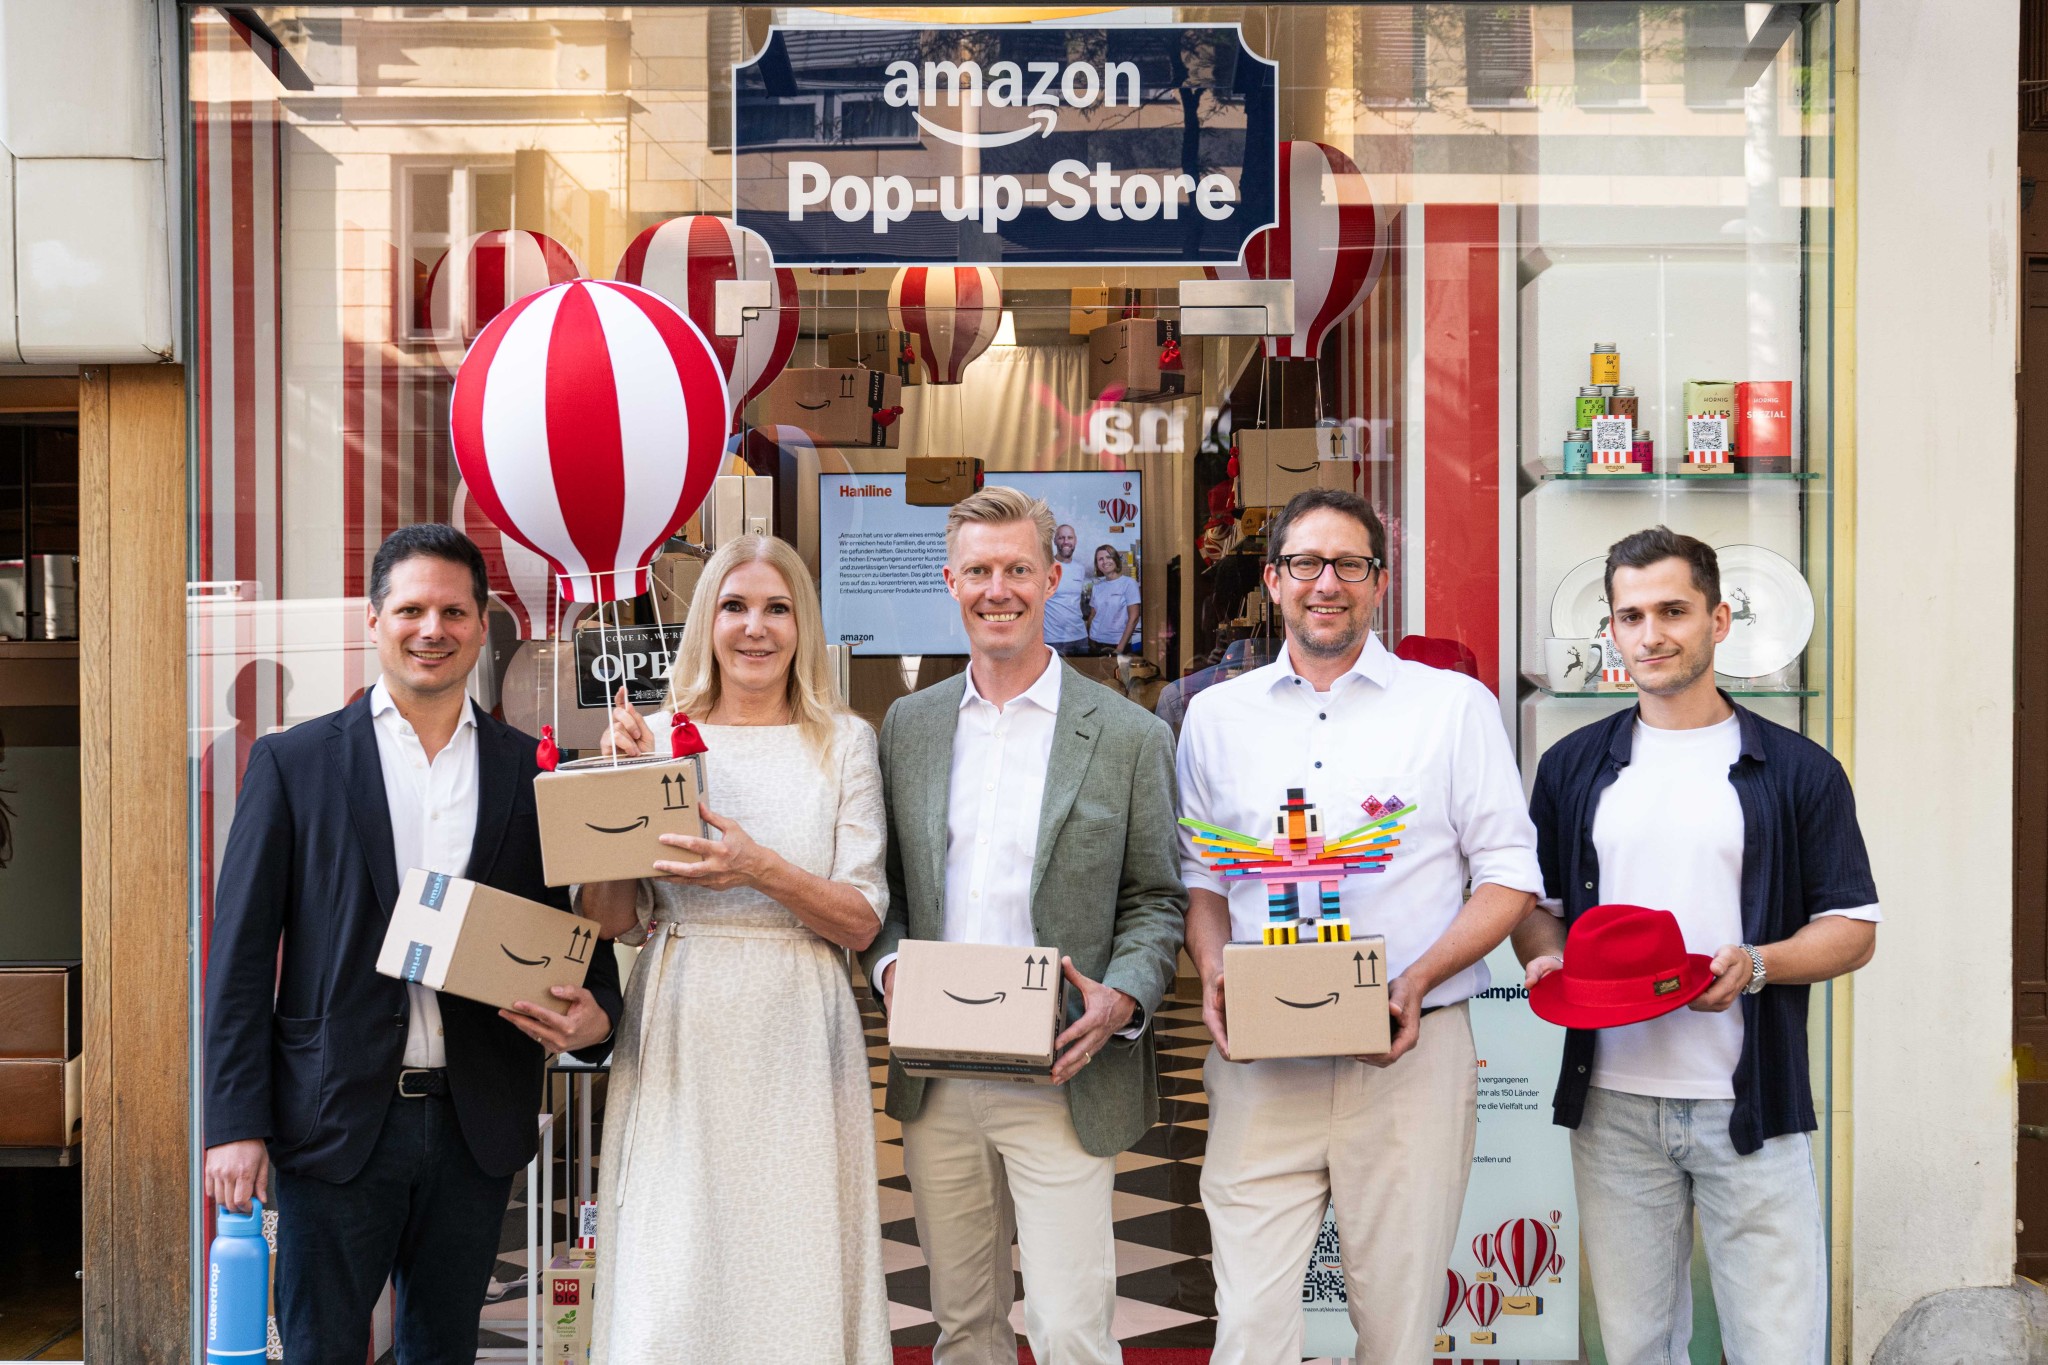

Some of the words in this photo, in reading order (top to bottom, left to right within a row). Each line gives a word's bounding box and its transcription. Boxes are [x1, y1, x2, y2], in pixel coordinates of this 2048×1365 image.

[884, 60, 1141, 109] amazon
[788, 159, 1236, 234] Pop-up-Store
[840, 485, 892, 497] Haniline
[606, 635, 634, 643] COME
[592, 651, 679, 682] OPE
[1482, 1077, 1529, 1085] vergangenen
[1515, 1089, 1540, 1097] Länder
[1487, 1102, 1498, 1110] die
[1499, 1102, 1523, 1110] Vielfalt
[1524, 1102, 1538, 1110] und
[1319, 1255, 1342, 1263] ama
[555, 1281, 577, 1292] bio
[209, 1262, 220, 1341] waterdrop
[555, 1292, 577, 1303] blo
[563, 1344, 570, 1352] 5
